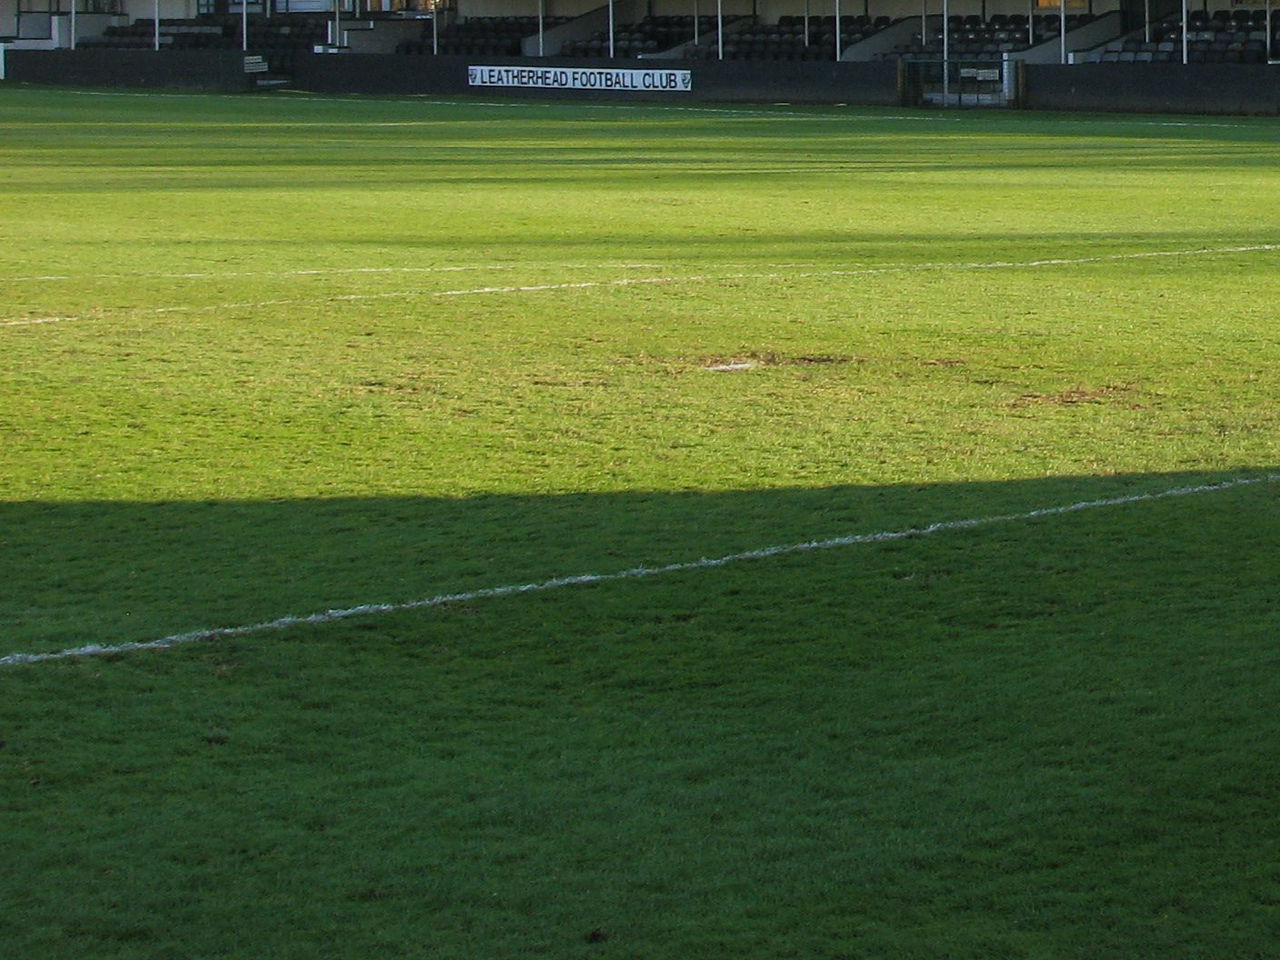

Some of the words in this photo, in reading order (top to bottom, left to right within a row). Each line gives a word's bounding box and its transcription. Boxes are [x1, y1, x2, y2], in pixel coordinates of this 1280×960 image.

[480, 69, 568, 87] LEATHERHEAD
[572, 71, 638, 88] FOOTBALL
[642, 73, 678, 89] CLUB
